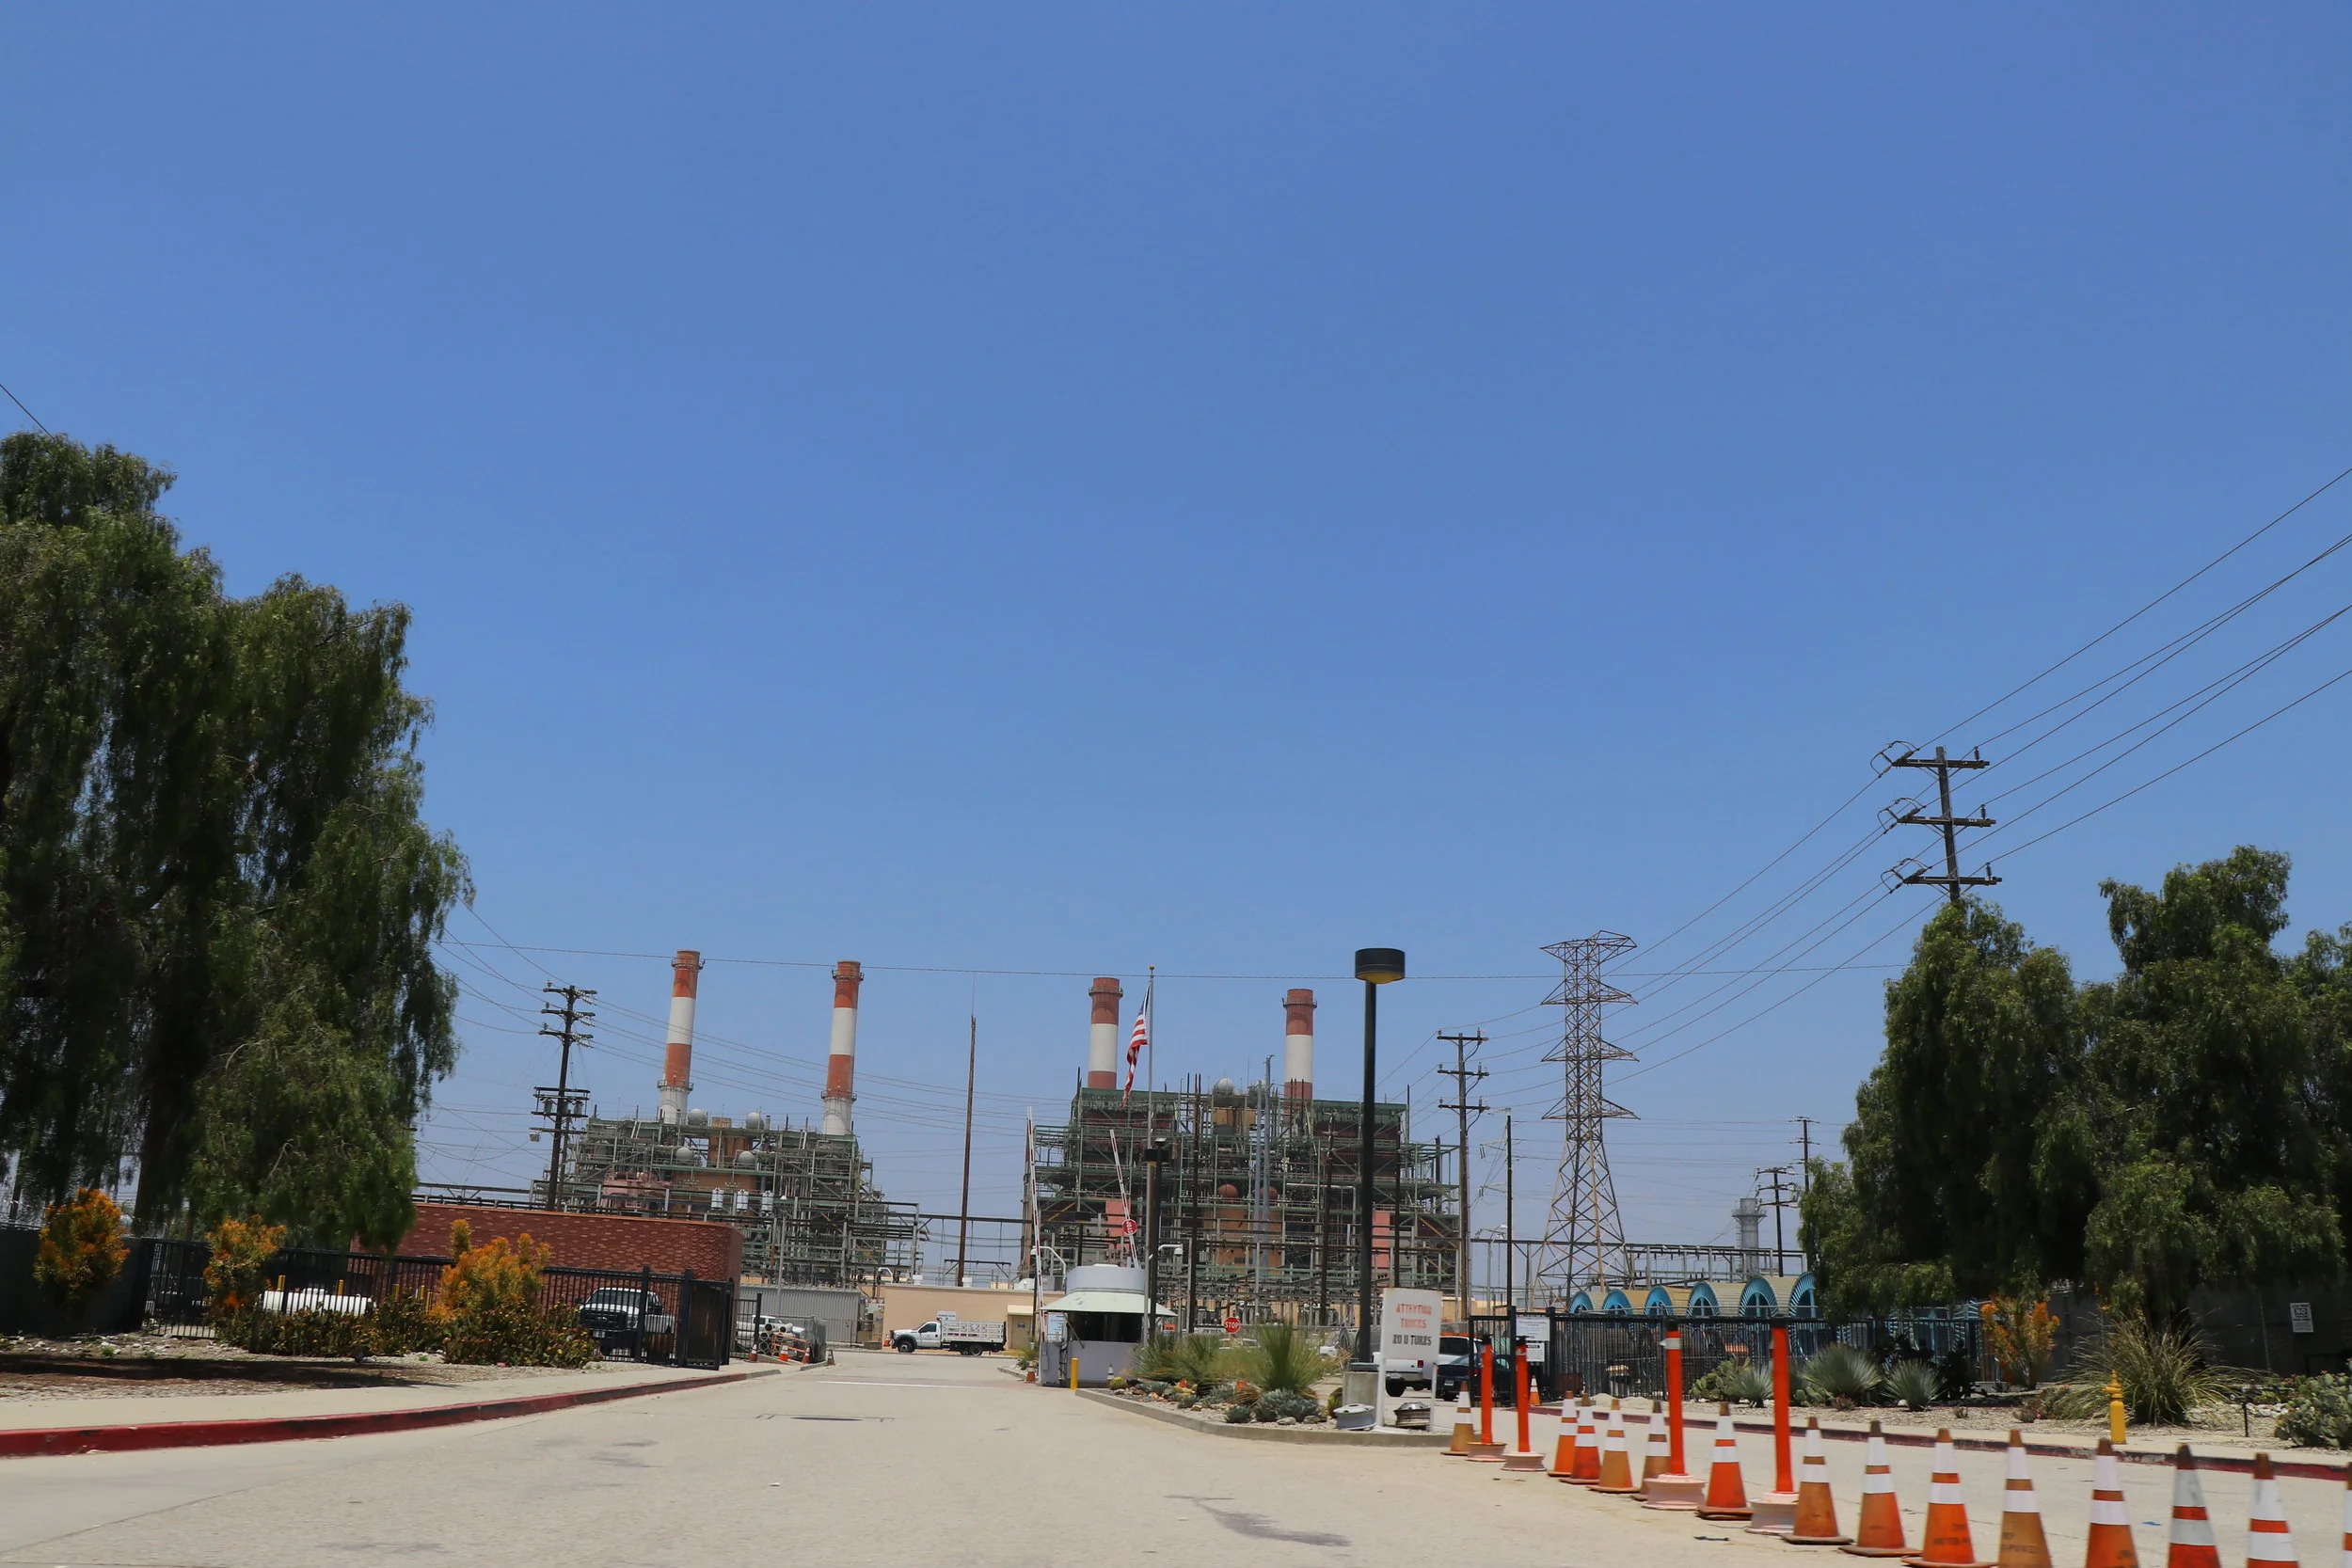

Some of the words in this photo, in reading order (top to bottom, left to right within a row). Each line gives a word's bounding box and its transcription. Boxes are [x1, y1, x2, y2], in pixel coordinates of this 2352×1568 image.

[1392, 1334, 1403, 1345] NO
[1404, 1335, 1408, 1345] U
[1410, 1335, 1432, 1346] TURNS
